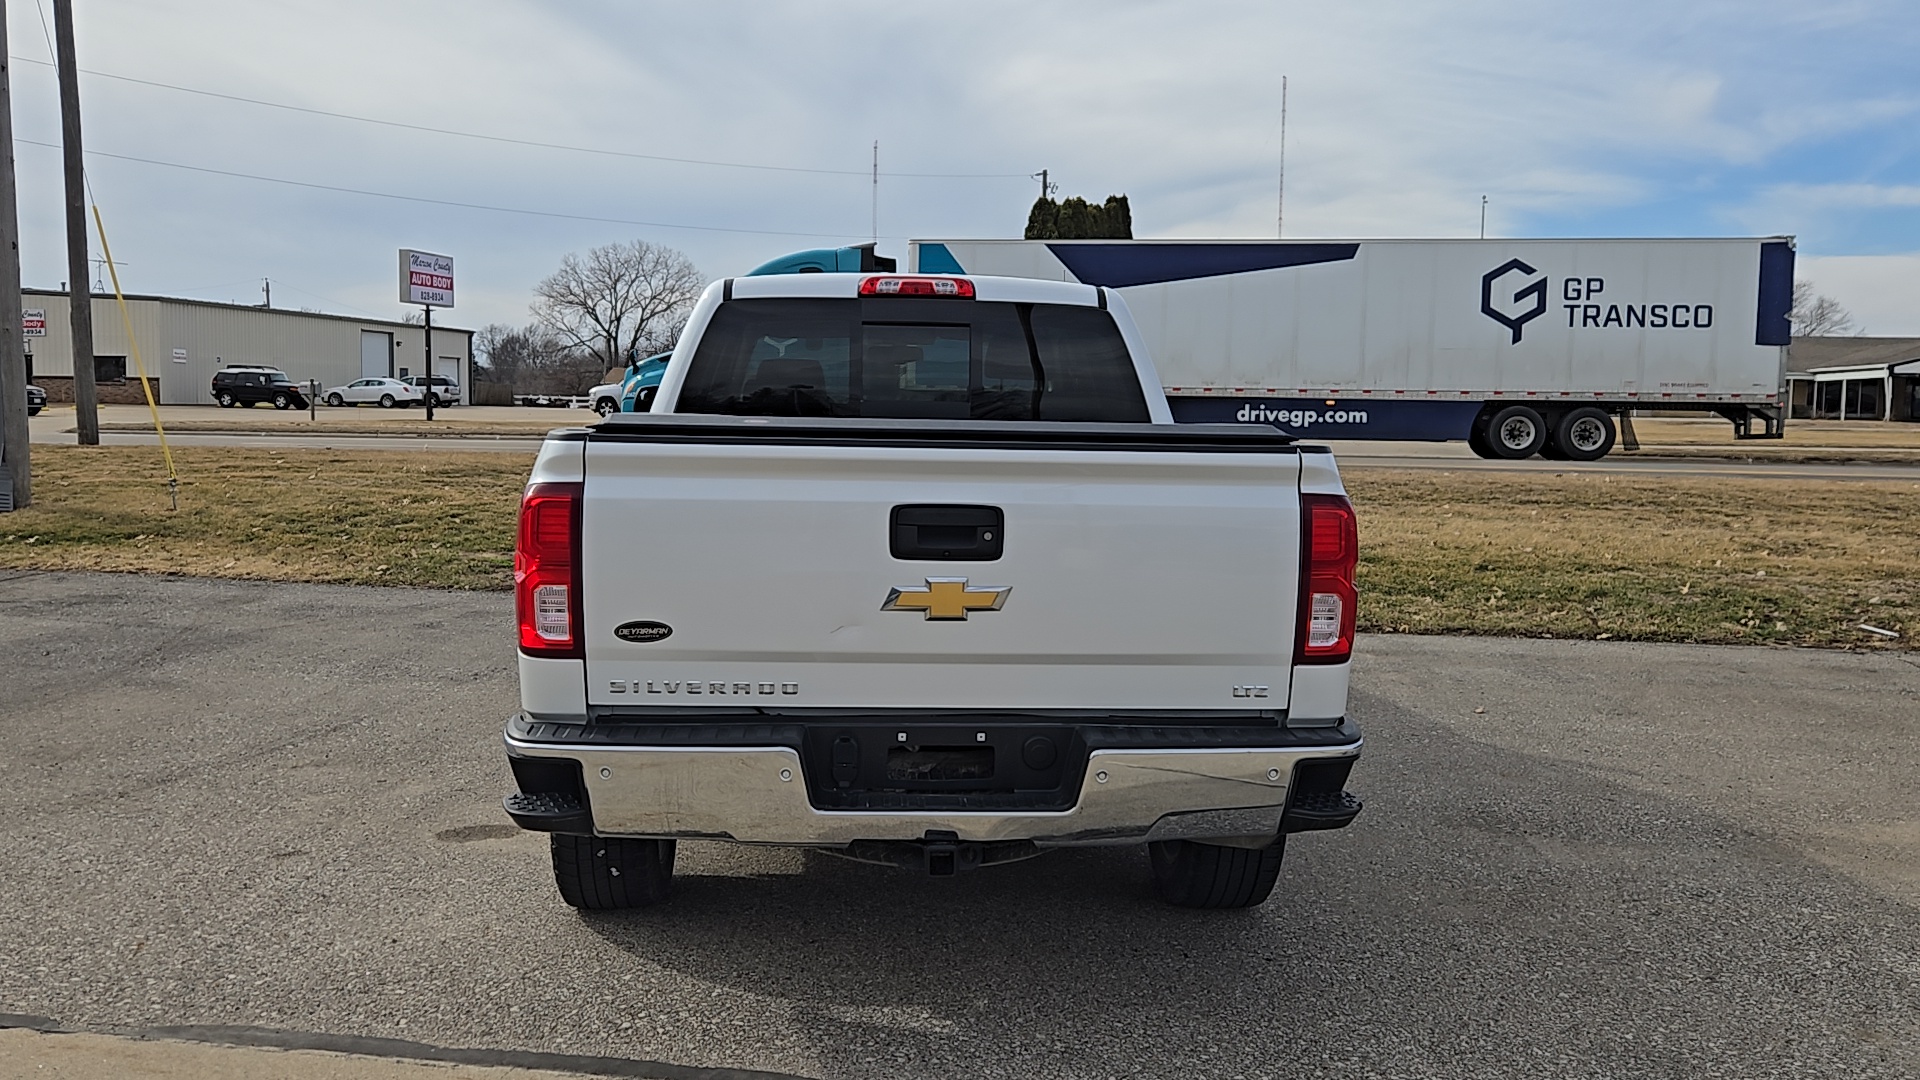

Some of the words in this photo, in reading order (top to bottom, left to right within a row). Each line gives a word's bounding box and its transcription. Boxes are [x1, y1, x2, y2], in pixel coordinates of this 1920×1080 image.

[411, 273, 432, 286] AUTO
[432, 276, 452, 289] BODY
[1563, 278, 1605, 300] GP
[1563, 304, 1714, 328] TRANSCO
[1236, 403, 1368, 428] drivegp.com
[618, 627, 669, 635] DEYARMAN
[609, 679, 800, 696] SILVERADO
[1232, 685, 1269, 698] LTZ
